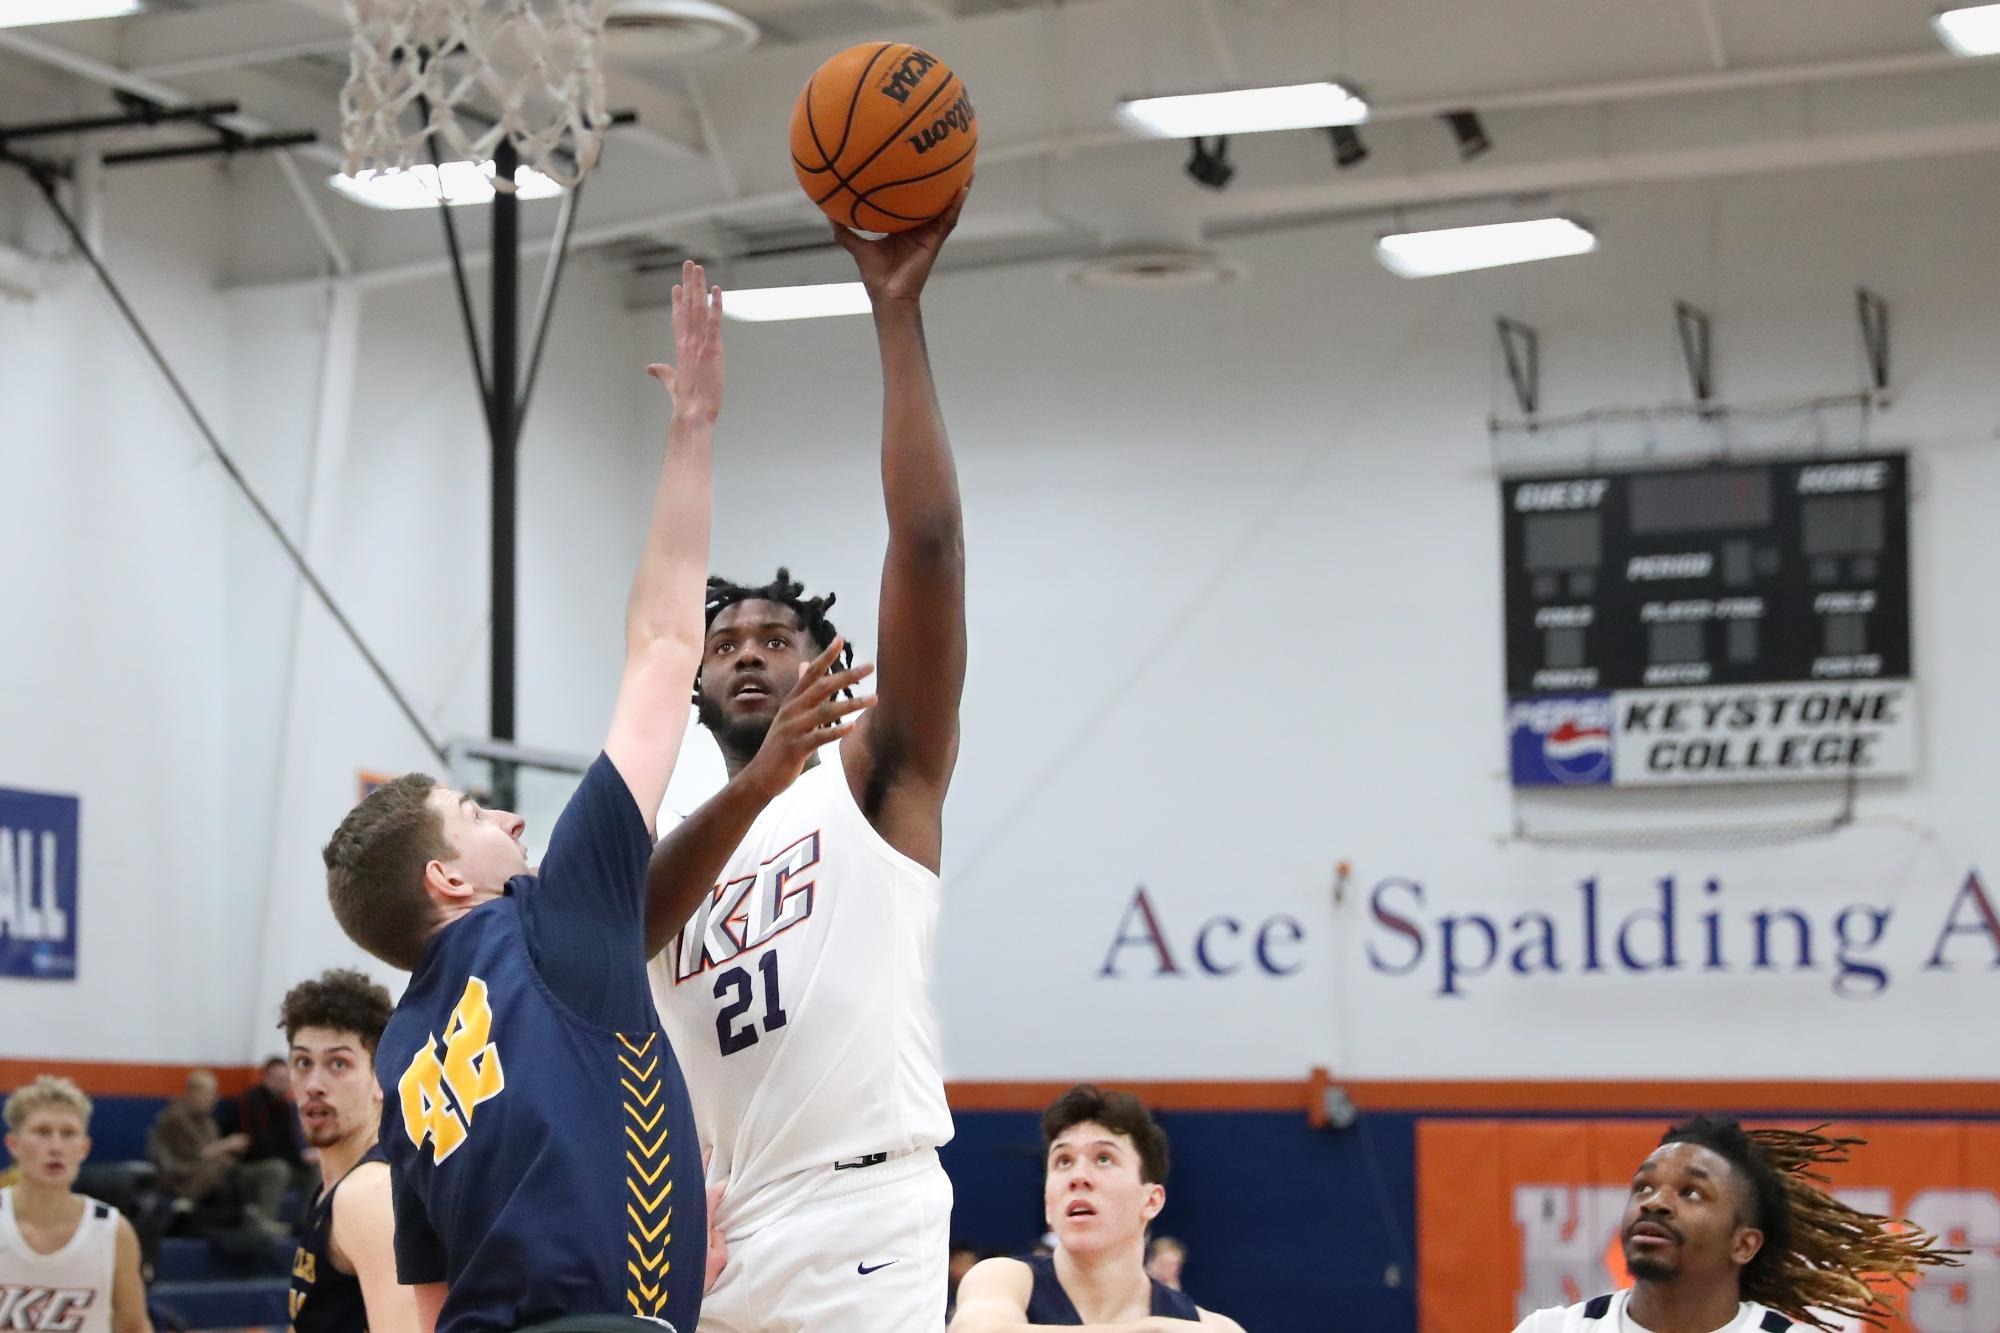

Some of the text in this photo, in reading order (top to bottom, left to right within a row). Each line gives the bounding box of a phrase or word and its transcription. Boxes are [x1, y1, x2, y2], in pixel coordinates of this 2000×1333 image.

[881, 49, 938, 104] NCAA
[1623, 690, 1900, 733] KEYSTONE
[1647, 735, 1880, 773] COLLEGE
[675, 829, 821, 986] KC
[1099, 885, 1307, 977] Ace
[1364, 875, 1892, 998] Spalding
[713, 948, 788, 1057] 21
[398, 975, 505, 1167] 42
